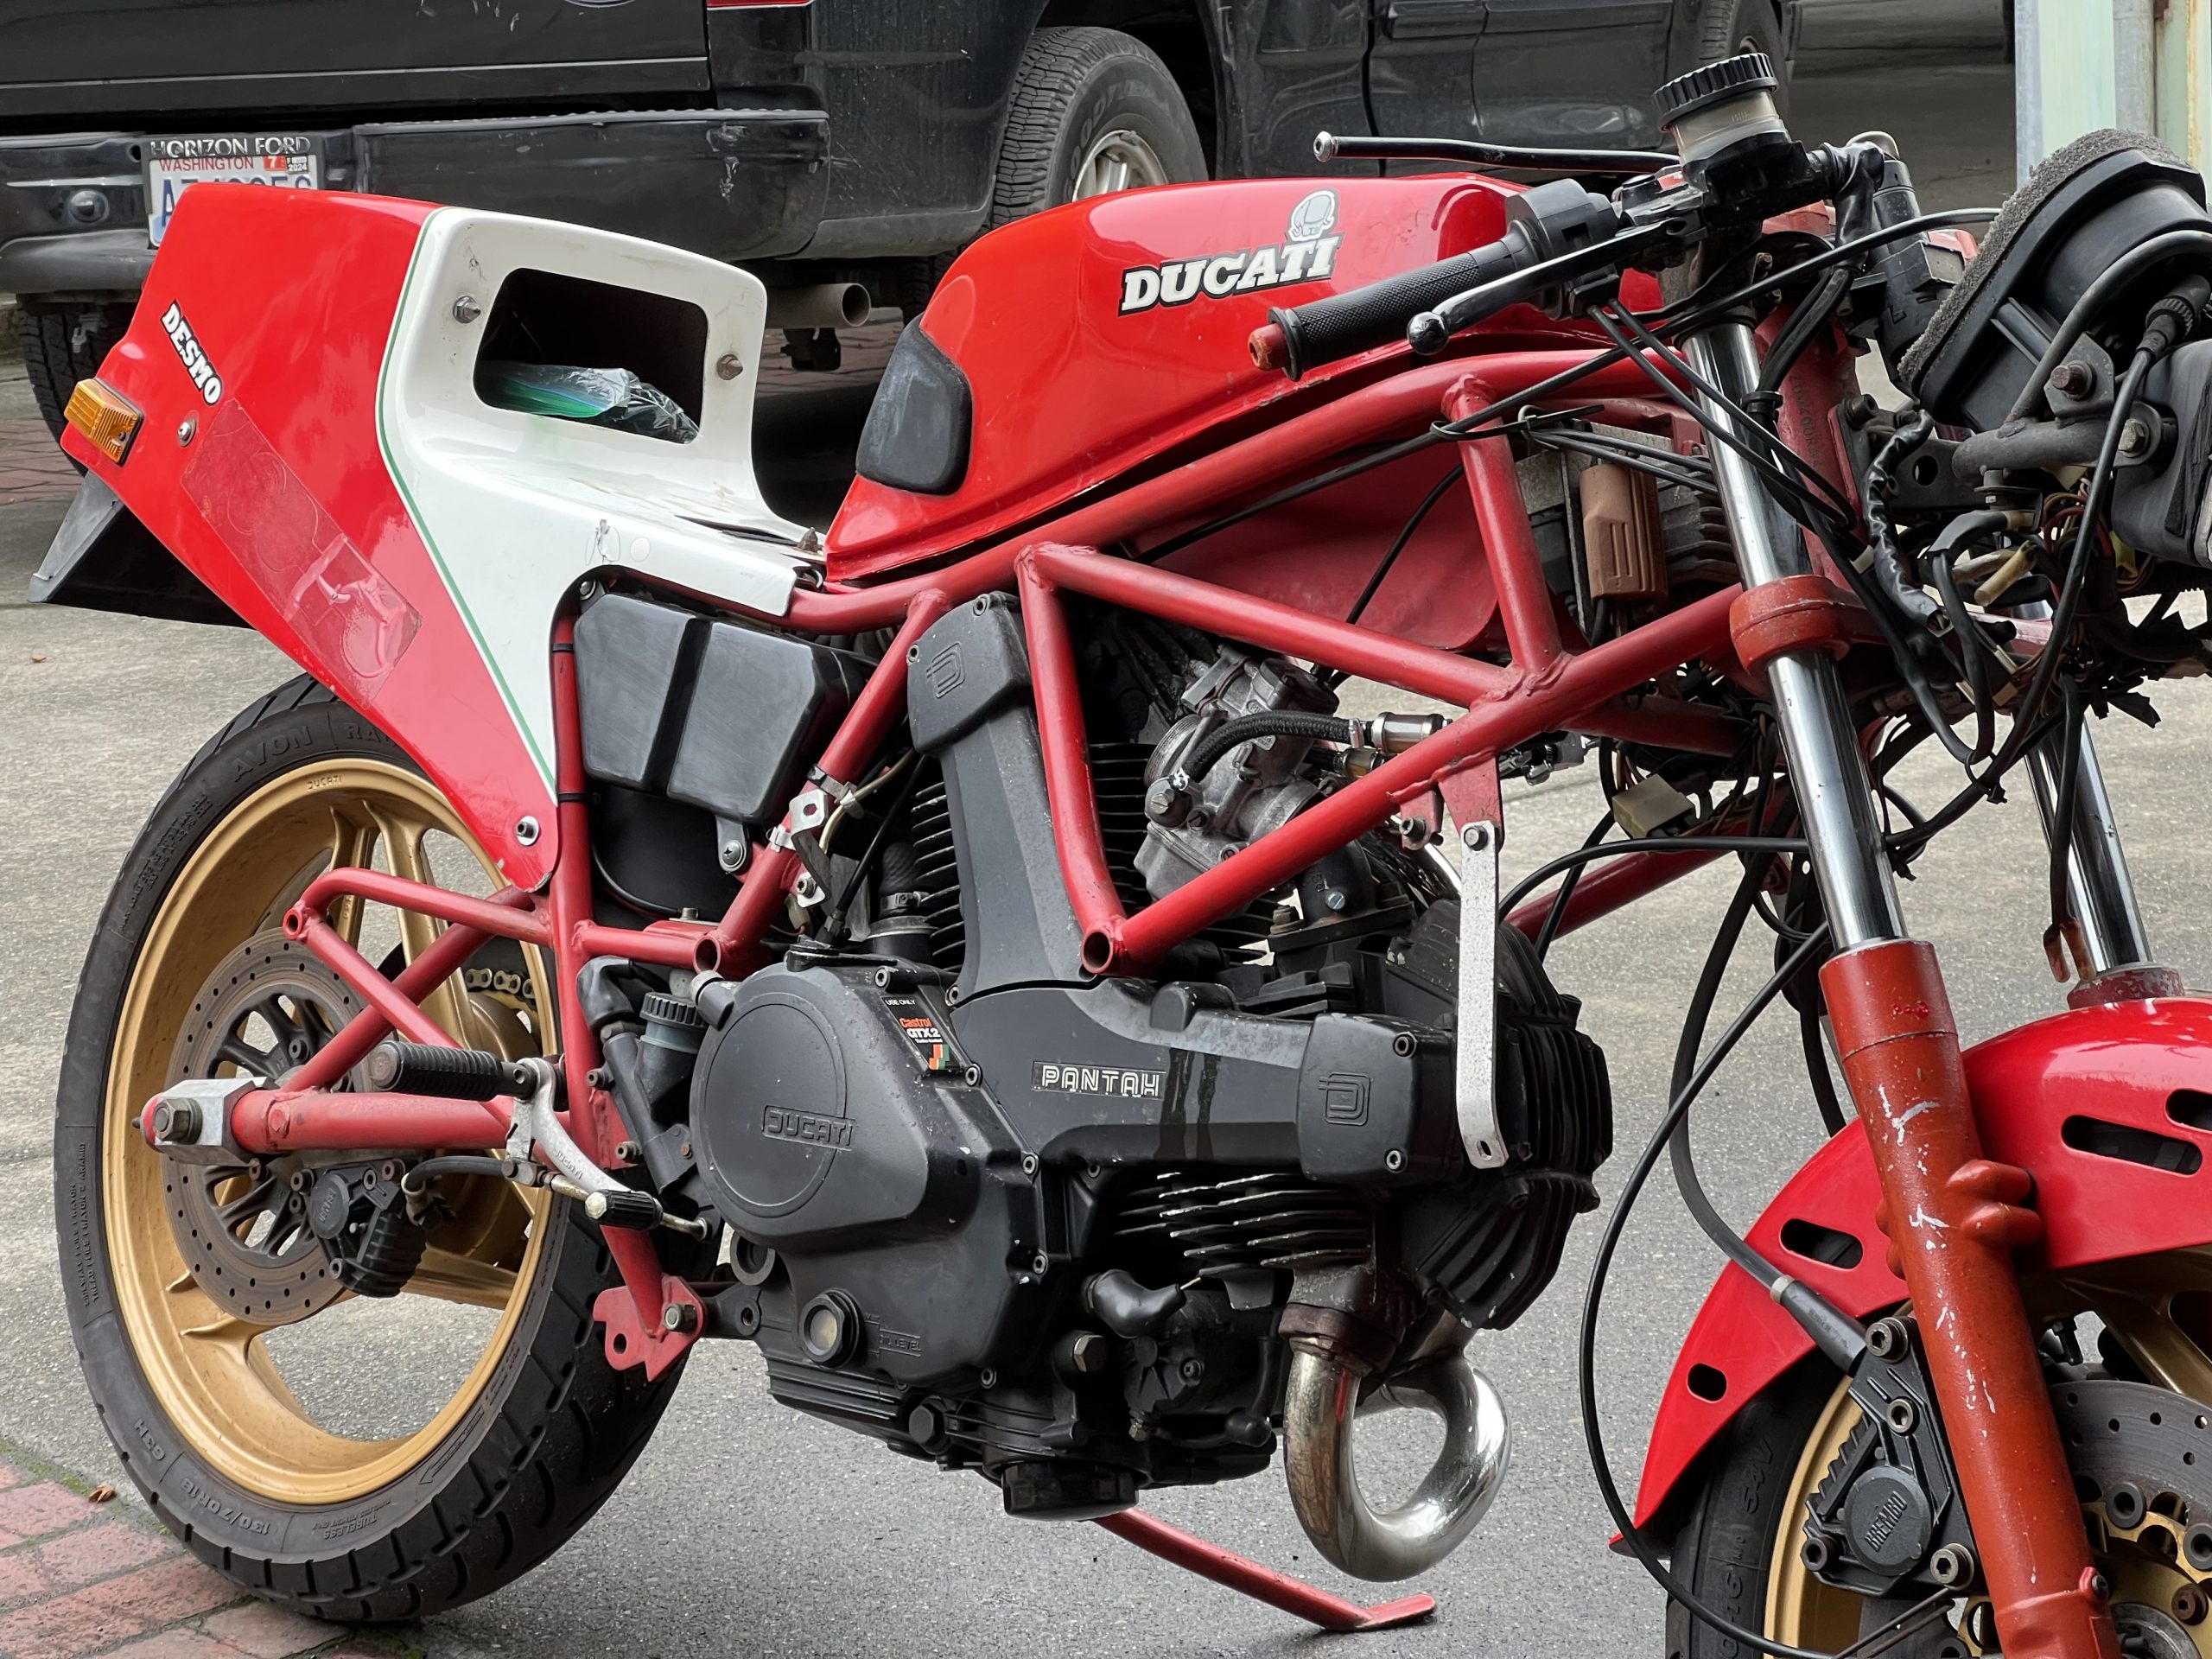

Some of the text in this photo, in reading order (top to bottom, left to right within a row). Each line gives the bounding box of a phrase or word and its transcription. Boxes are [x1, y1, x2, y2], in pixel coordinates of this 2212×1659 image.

[150, 137, 311, 157] HORIZON FORD
[159, 156, 254, 172] WASHINGTON
[268, 156, 277, 168] 7
[288, 162, 308, 172] 2024
[1122, 235, 1340, 312] DUCATI
[161, 301, 222, 405] DESMO
[232, 725, 313, 783] AVON
[899, 1017, 932, 1028] Castrol
[1041, 1065, 1160, 1096] PANTAH
[767, 1109, 854, 1147] DUCATI
[134, 1418, 166, 1461] 63H
[1864, 1490, 1908, 1553] BREMBO
